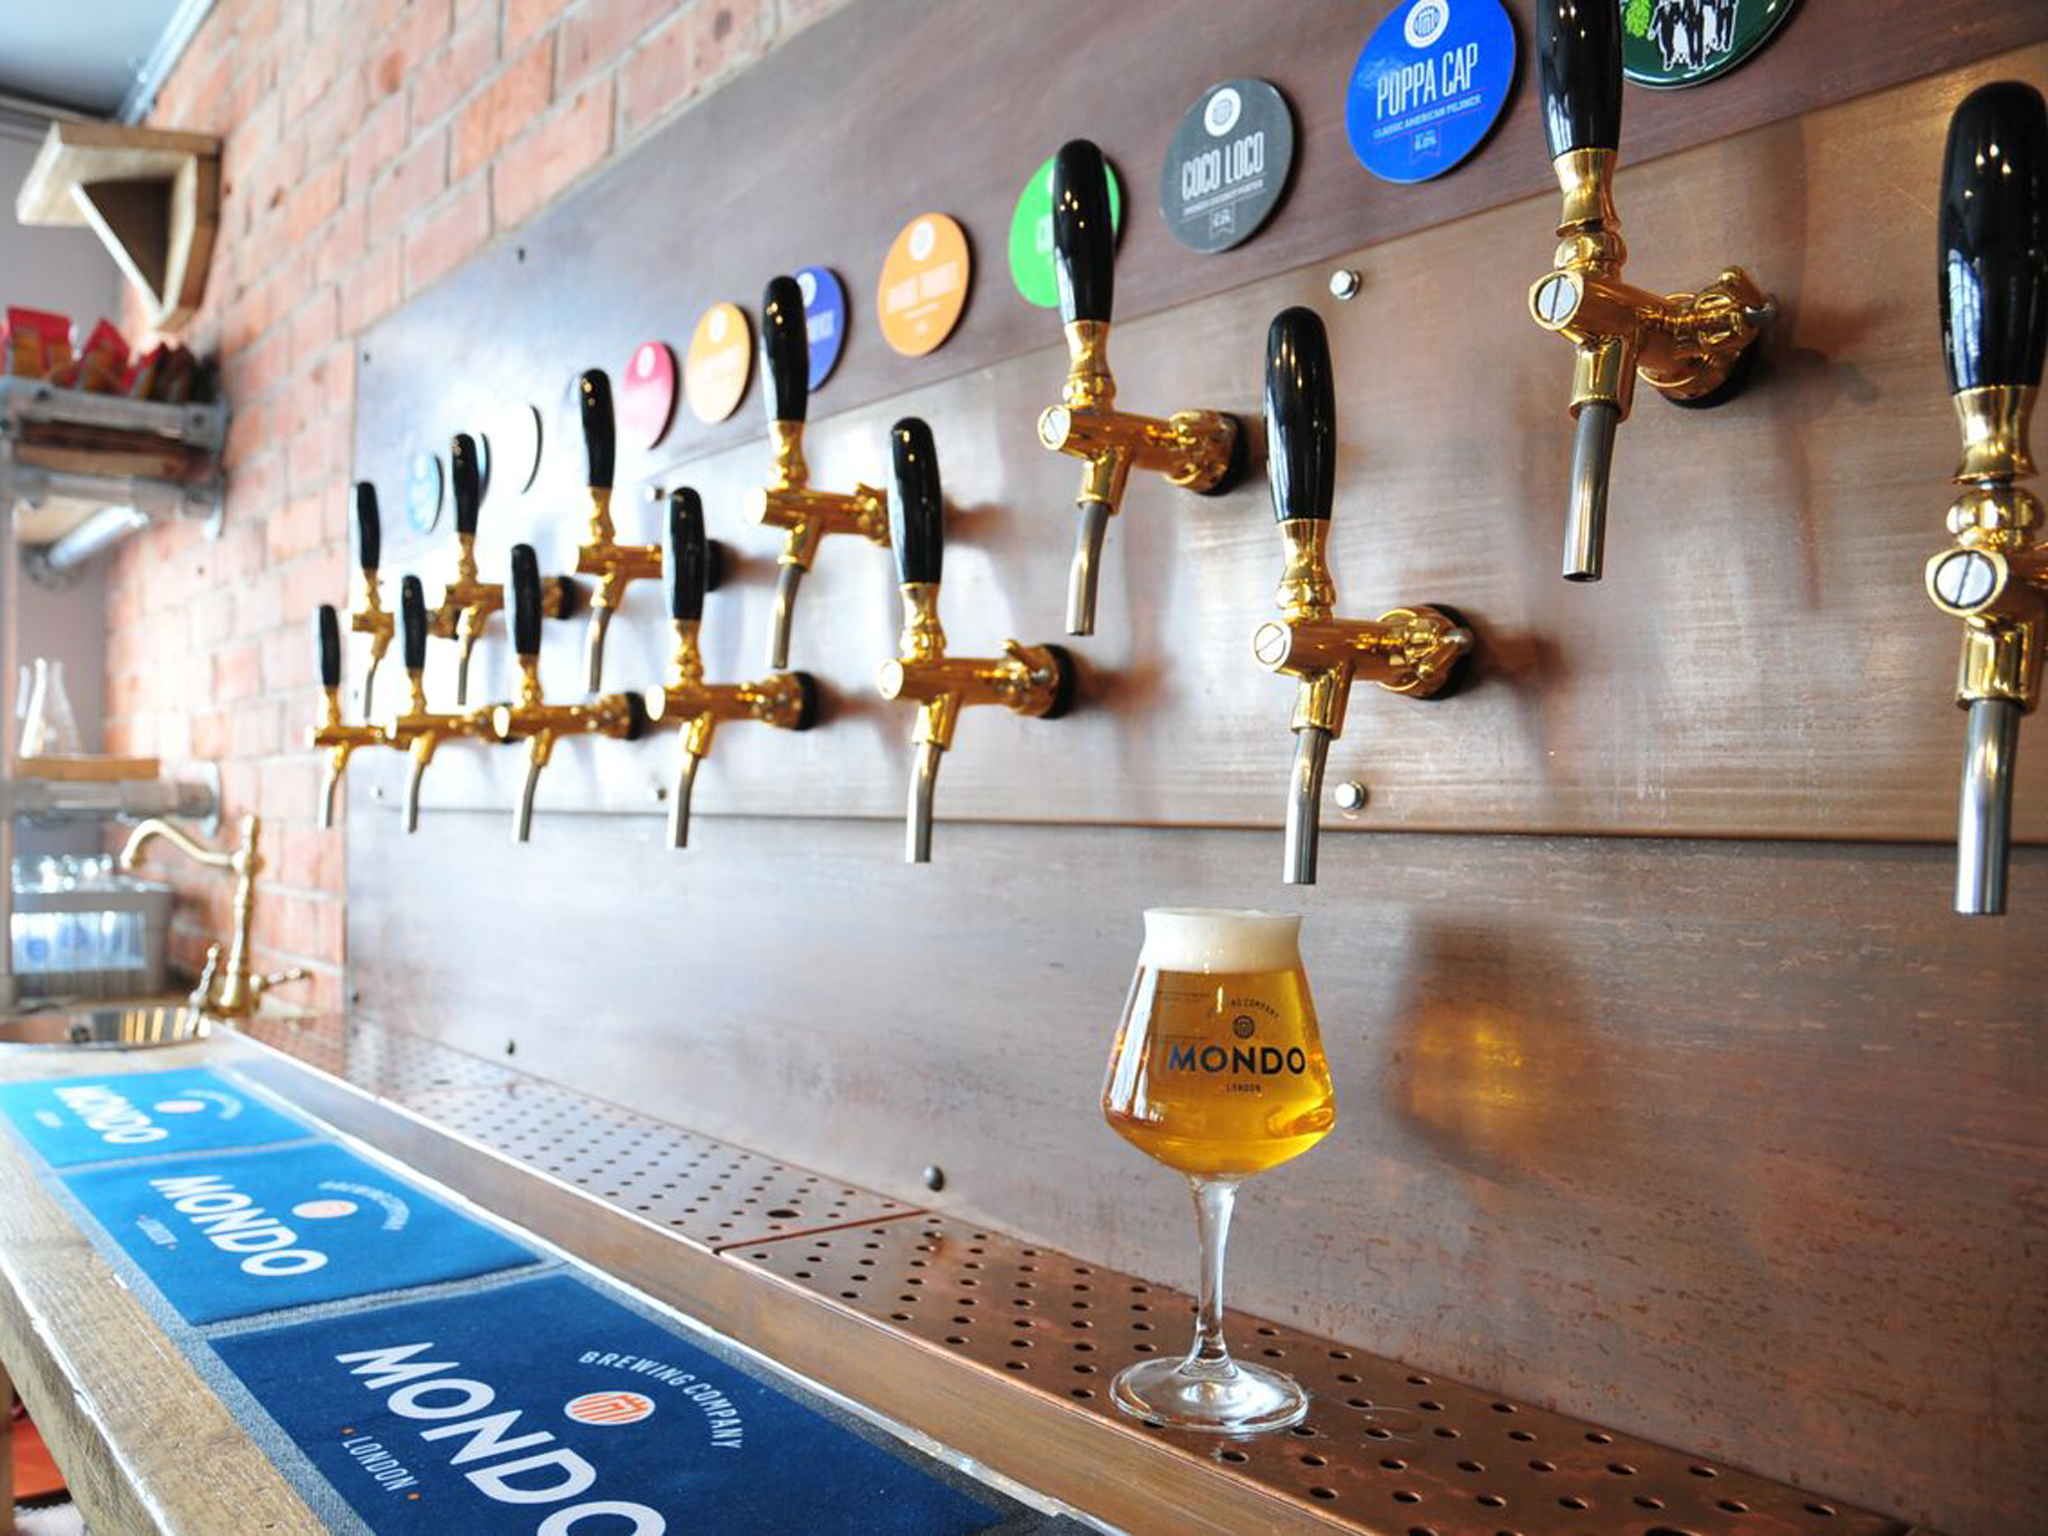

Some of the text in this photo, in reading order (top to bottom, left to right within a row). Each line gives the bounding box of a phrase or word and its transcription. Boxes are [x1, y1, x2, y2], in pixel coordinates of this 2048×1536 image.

[1376, 43, 1479, 120] POPPA CAP
[1181, 149, 1221, 201] COCO
[1224, 131, 1265, 184] LOCO
[1168, 1046, 1306, 1076] MONDO
[149, 1175, 329, 1276] MONDO
[578, 1351, 744, 1448] BREWING COMPANY
[335, 1342, 667, 1536] MONDO
[341, 1435, 420, 1492] LONDON
